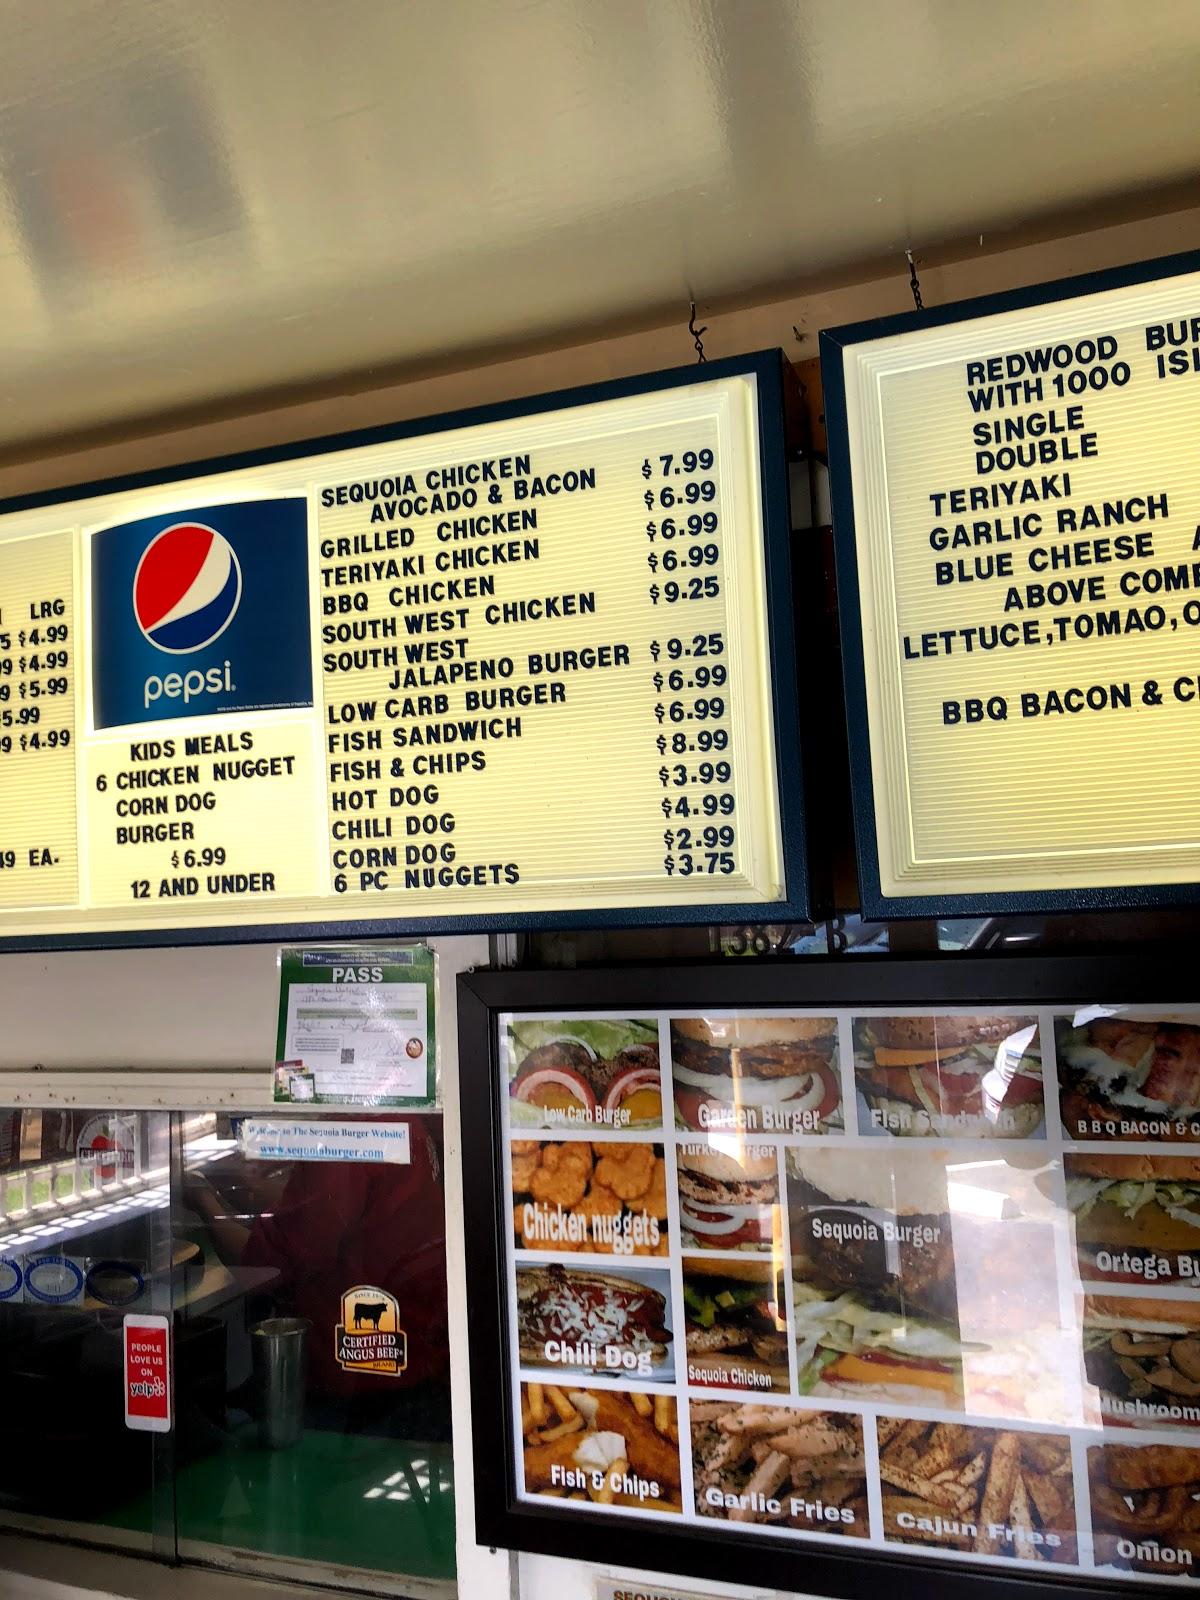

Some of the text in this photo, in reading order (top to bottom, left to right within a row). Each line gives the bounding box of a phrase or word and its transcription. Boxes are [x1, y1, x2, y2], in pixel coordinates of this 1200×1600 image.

[967, 335, 1118, 386] REDWOOD
[968, 378, 1043, 412] WITH
[1053, 362, 1130, 397] 1000
[973, 406, 1084, 446] SINGLE
[976, 433, 1098, 474] DOUBLE
[322, 455, 530, 507] SEQUOIA CHICKEN
[370, 468, 595, 522] AVOCADO & BACON
[930, 473, 1071, 516] TERIYAKI
[321, 509, 537, 558] GRILLED CHICKEN
[930, 494, 1168, 551] GARLIC RANCH
[322, 539, 539, 587] TERIYAKI CHICKEN
[936, 553, 1013, 585] BLUE
[1029, 533, 1154, 572] CHEESE
[31, 599, 64, 619] LRG
[323, 576, 494, 615] BBQ CHICKEN
[1004, 576, 1105, 612] ABOVE
[323, 593, 595, 644] SOUTH WEST CHICKEN
[19, 624, 68, 647] $4.99
[19, 651, 68, 672] $4.99
[324, 639, 468, 672] SOUTH WEST
[389, 645, 629, 689] JALAPENO BURGER
[19, 677, 68, 699] $5.99
[144, 660, 231, 708] pepsi
[329, 702, 376, 723] LOW
[385, 695, 448, 718] CARB
[466, 683, 565, 710] BURGER
[943, 697, 1007, 724] BBQ
[1021, 684, 1131, 717] BACON
[1142, 681, 1162, 705] &
[20, 729, 70, 751] $4.99
[131, 732, 252, 761] KIDS MEALS
[329, 717, 521, 753] FISH SANDWICH
[97, 756, 294, 791] 6 CHICKEN NUGGET
[331, 751, 485, 782] FISH & CHIPS
[117, 792, 215, 816] CORN DOG
[333, 785, 438, 810] HOT DOG
[117, 822, 193, 844] BURGER
[333, 813, 455, 839] CHILI DOG
[29, 848, 59, 866] EA.
[334, 843, 455, 869] CORN DOG
[131, 873, 274, 898] 12 AND UNDER
[335, 864, 519, 892] 6 PC NUGGETS
[332, 967, 384, 982] PASS
[544, 1106, 631, 1129] Low Carb Burger
[762, 1104, 820, 1135] Burger
[871, 1109, 911, 1128] Fish
[1121, 1120, 1170, 1135] BACON
[1176, 1122, 1187, 1135] &
[293, 1128, 307, 1136] The
[342, 1128, 368, 1139] Burger
[371, 1129, 406, 1139] Website!
[523, 1202, 660, 1255] Chicken nuggets
[812, 1218, 941, 1248] Sequoia Burger
[1096, 1251, 1171, 1279] Ortega
[131, 1343, 162, 1353] PEOPLE
[339, 1347, 375, 1360] ANGUS
[343, 1334, 396, 1348] CERTIFIED
[130, 1356, 163, 1365] LOVE US
[141, 1368, 153, 1376] ON
[544, 1340, 653, 1376] Chili Dog
[130, 1382, 154, 1398] yelp
[688, 1367, 772, 1388] Sequoia Chicken
[550, 1465, 660, 1501] Fish & Chips
[705, 1487, 855, 1523] Garlic Fries
[897, 1512, 1062, 1548] Cajun Fries
[1117, 1539, 1192, 1565] Onion
